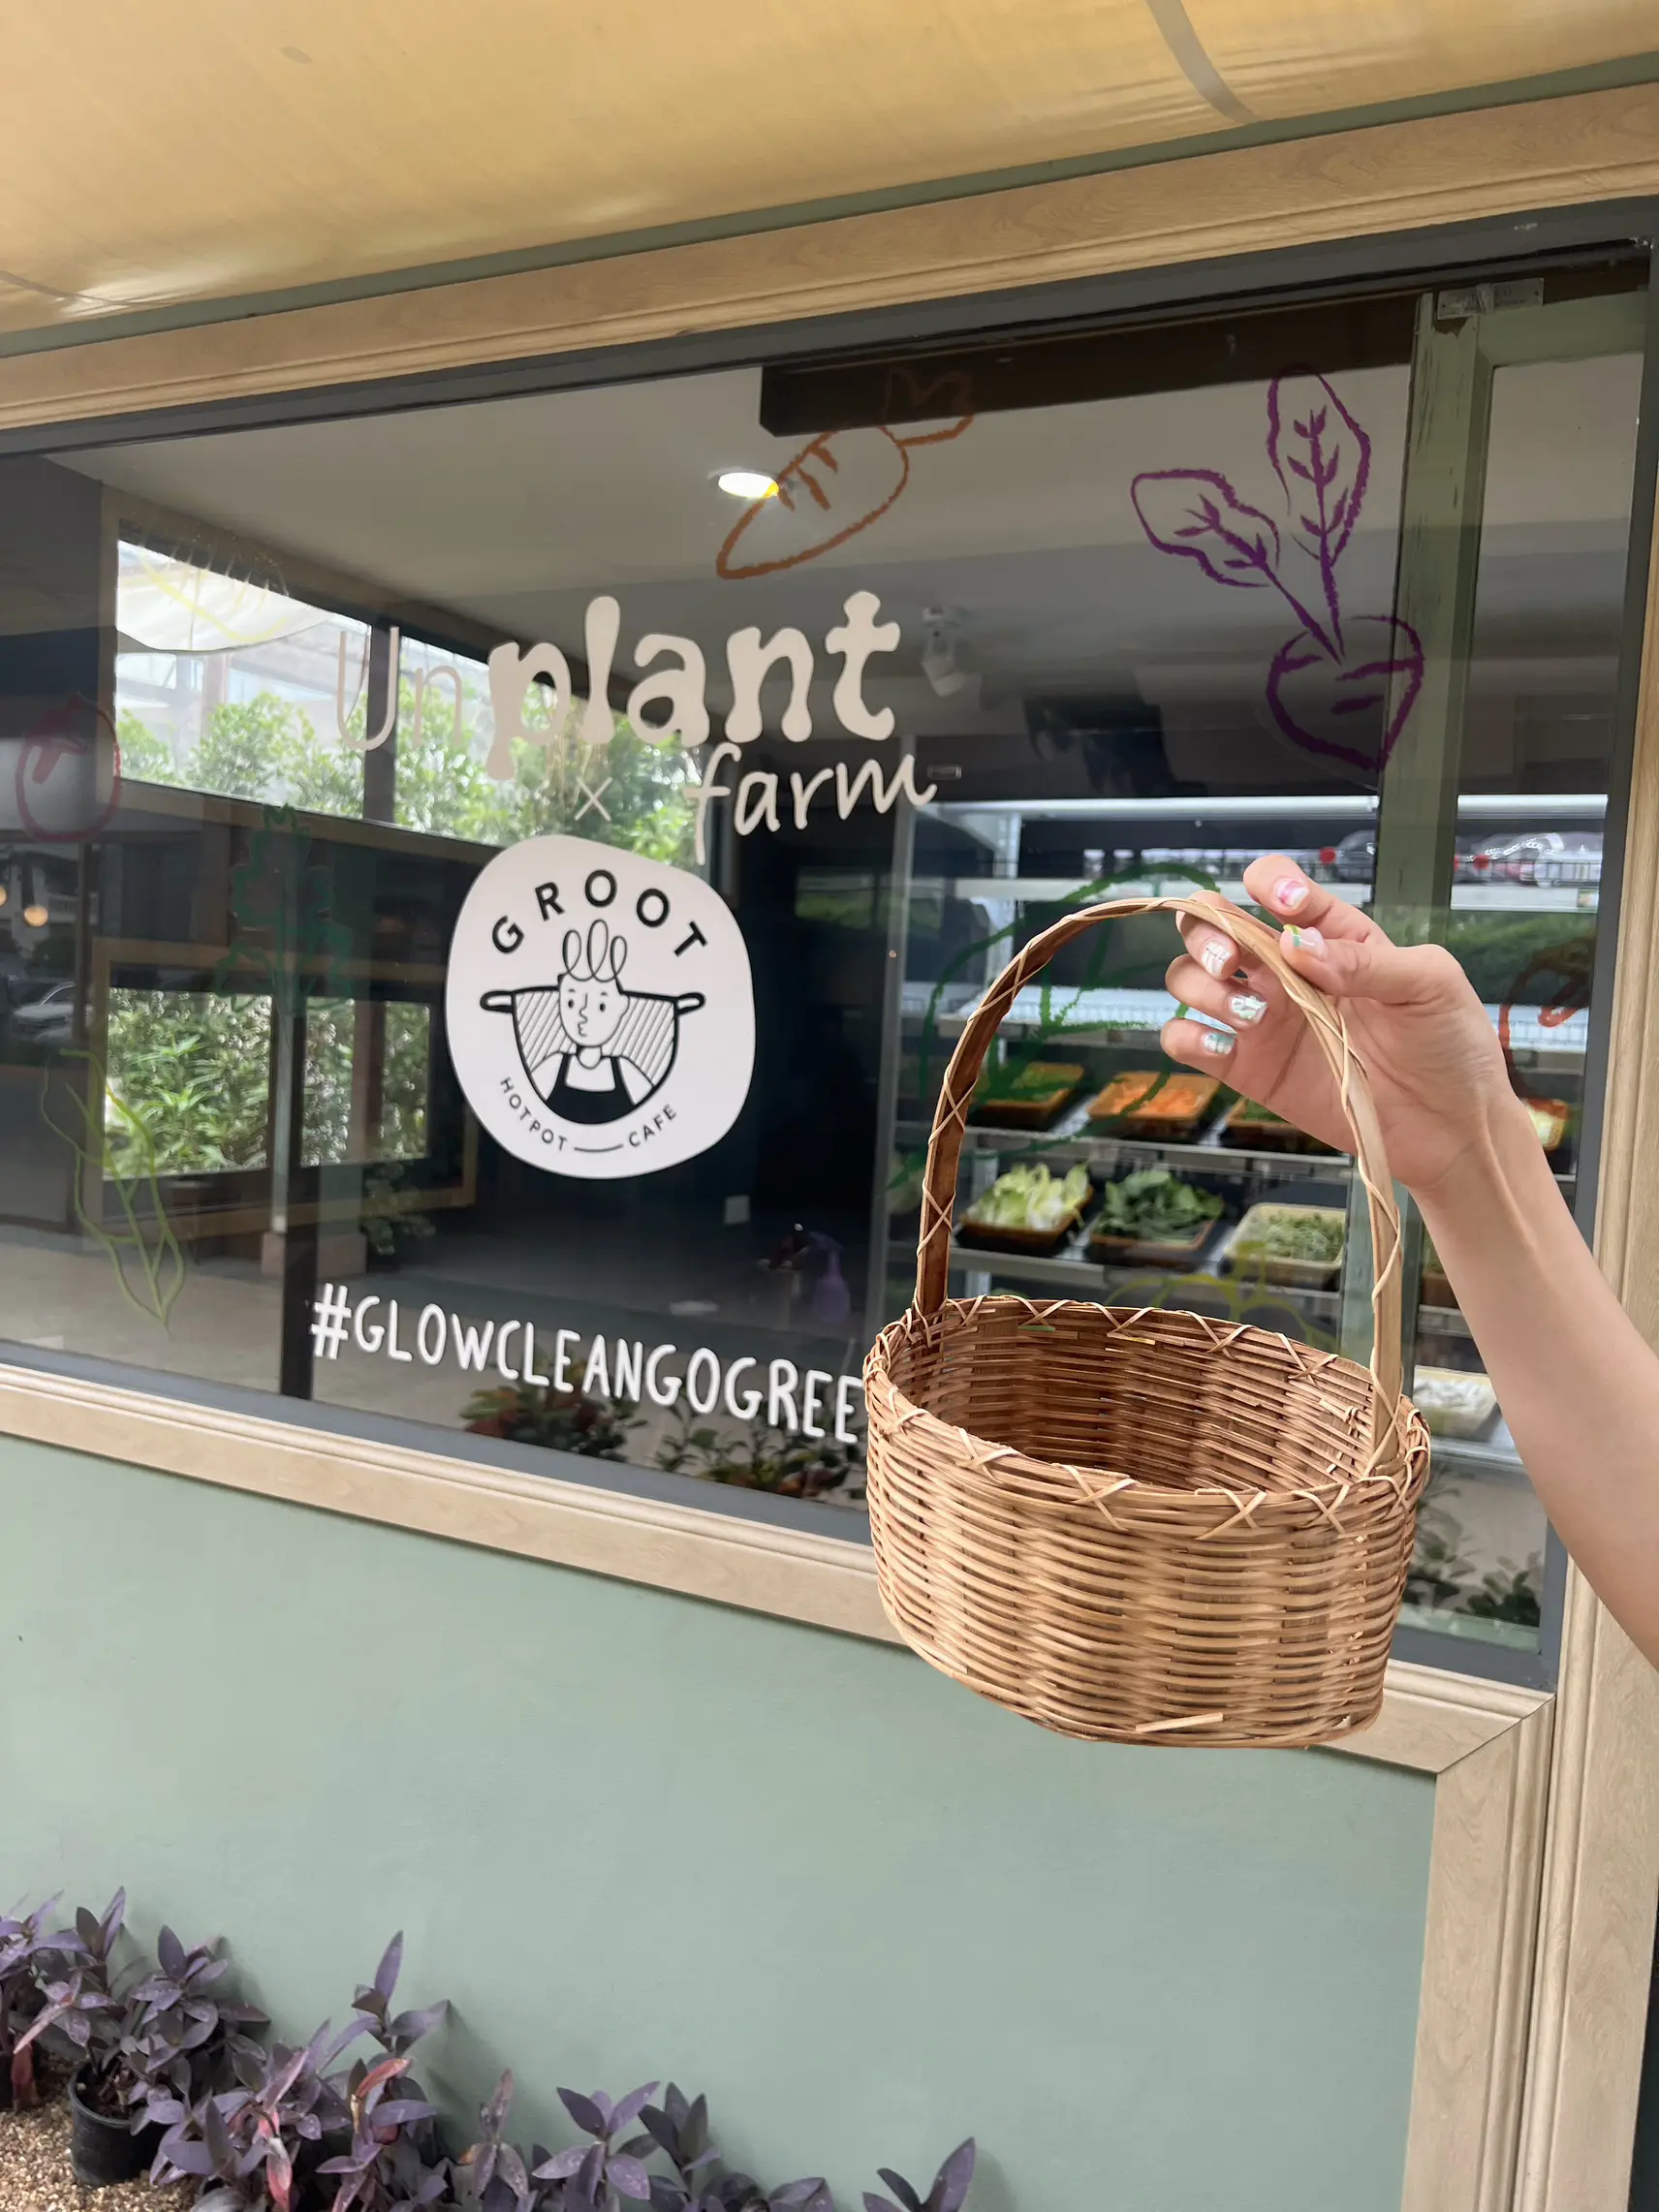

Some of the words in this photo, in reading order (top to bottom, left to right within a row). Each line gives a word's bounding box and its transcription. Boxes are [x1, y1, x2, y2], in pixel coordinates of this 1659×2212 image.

[684, 742, 938, 865] farm
[491, 870, 707, 955] GROOT
[500, 1076, 568, 1151] HOTPOT
[628, 1104, 677, 1148] CAFE
